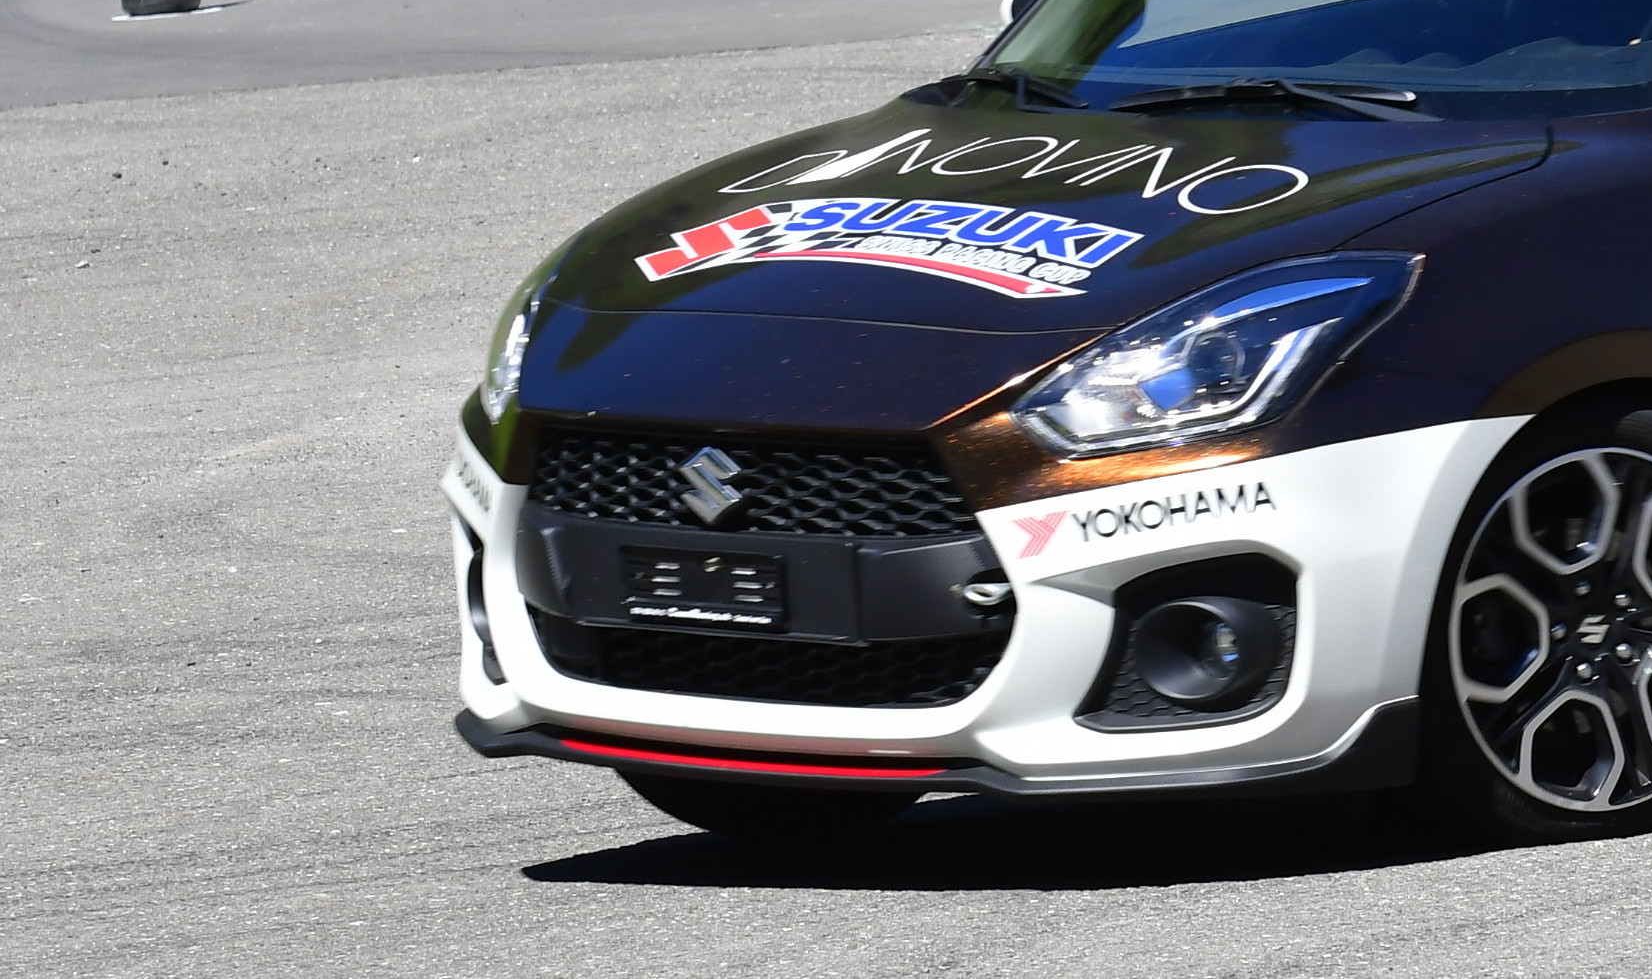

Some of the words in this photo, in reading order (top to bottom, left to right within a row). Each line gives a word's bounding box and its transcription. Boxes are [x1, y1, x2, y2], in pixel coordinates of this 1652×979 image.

[782, 199, 1138, 266] SUZUKI
[938, 243, 1038, 274] RACING
[1028, 260, 1092, 285] CUP
[1071, 481, 1277, 543] YOKOHAMA
